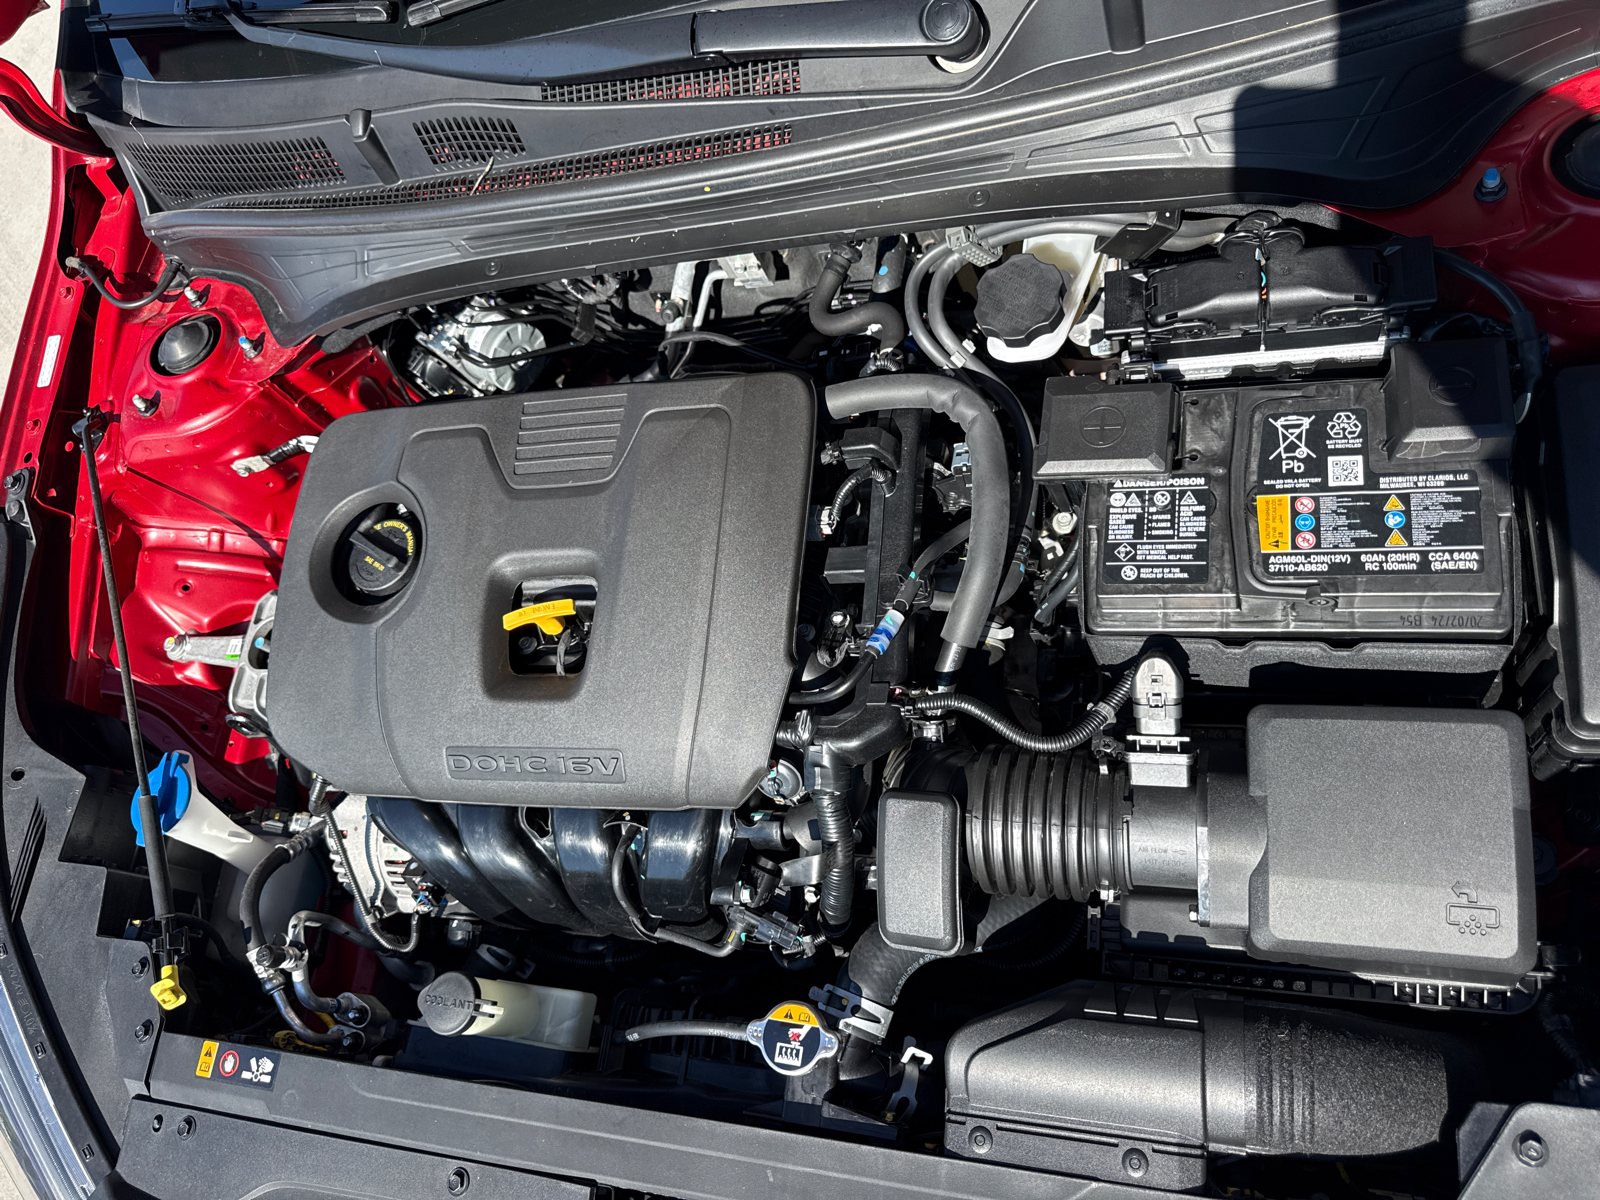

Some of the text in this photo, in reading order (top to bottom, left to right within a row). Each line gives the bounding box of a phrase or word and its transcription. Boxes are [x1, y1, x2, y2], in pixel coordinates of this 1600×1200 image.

[1282, 460, 1304, 473] Pb
[1269, 552, 1478, 564] AGM60L-DIN(12V) 60Ah (20HR) CCA 640A
[1269, 561, 1477, 572] 37110-AB620 RC 100min (SAE/EN)
[448, 754, 619, 776] DOHC 16V
[425, 994, 474, 1010] COOLANT
